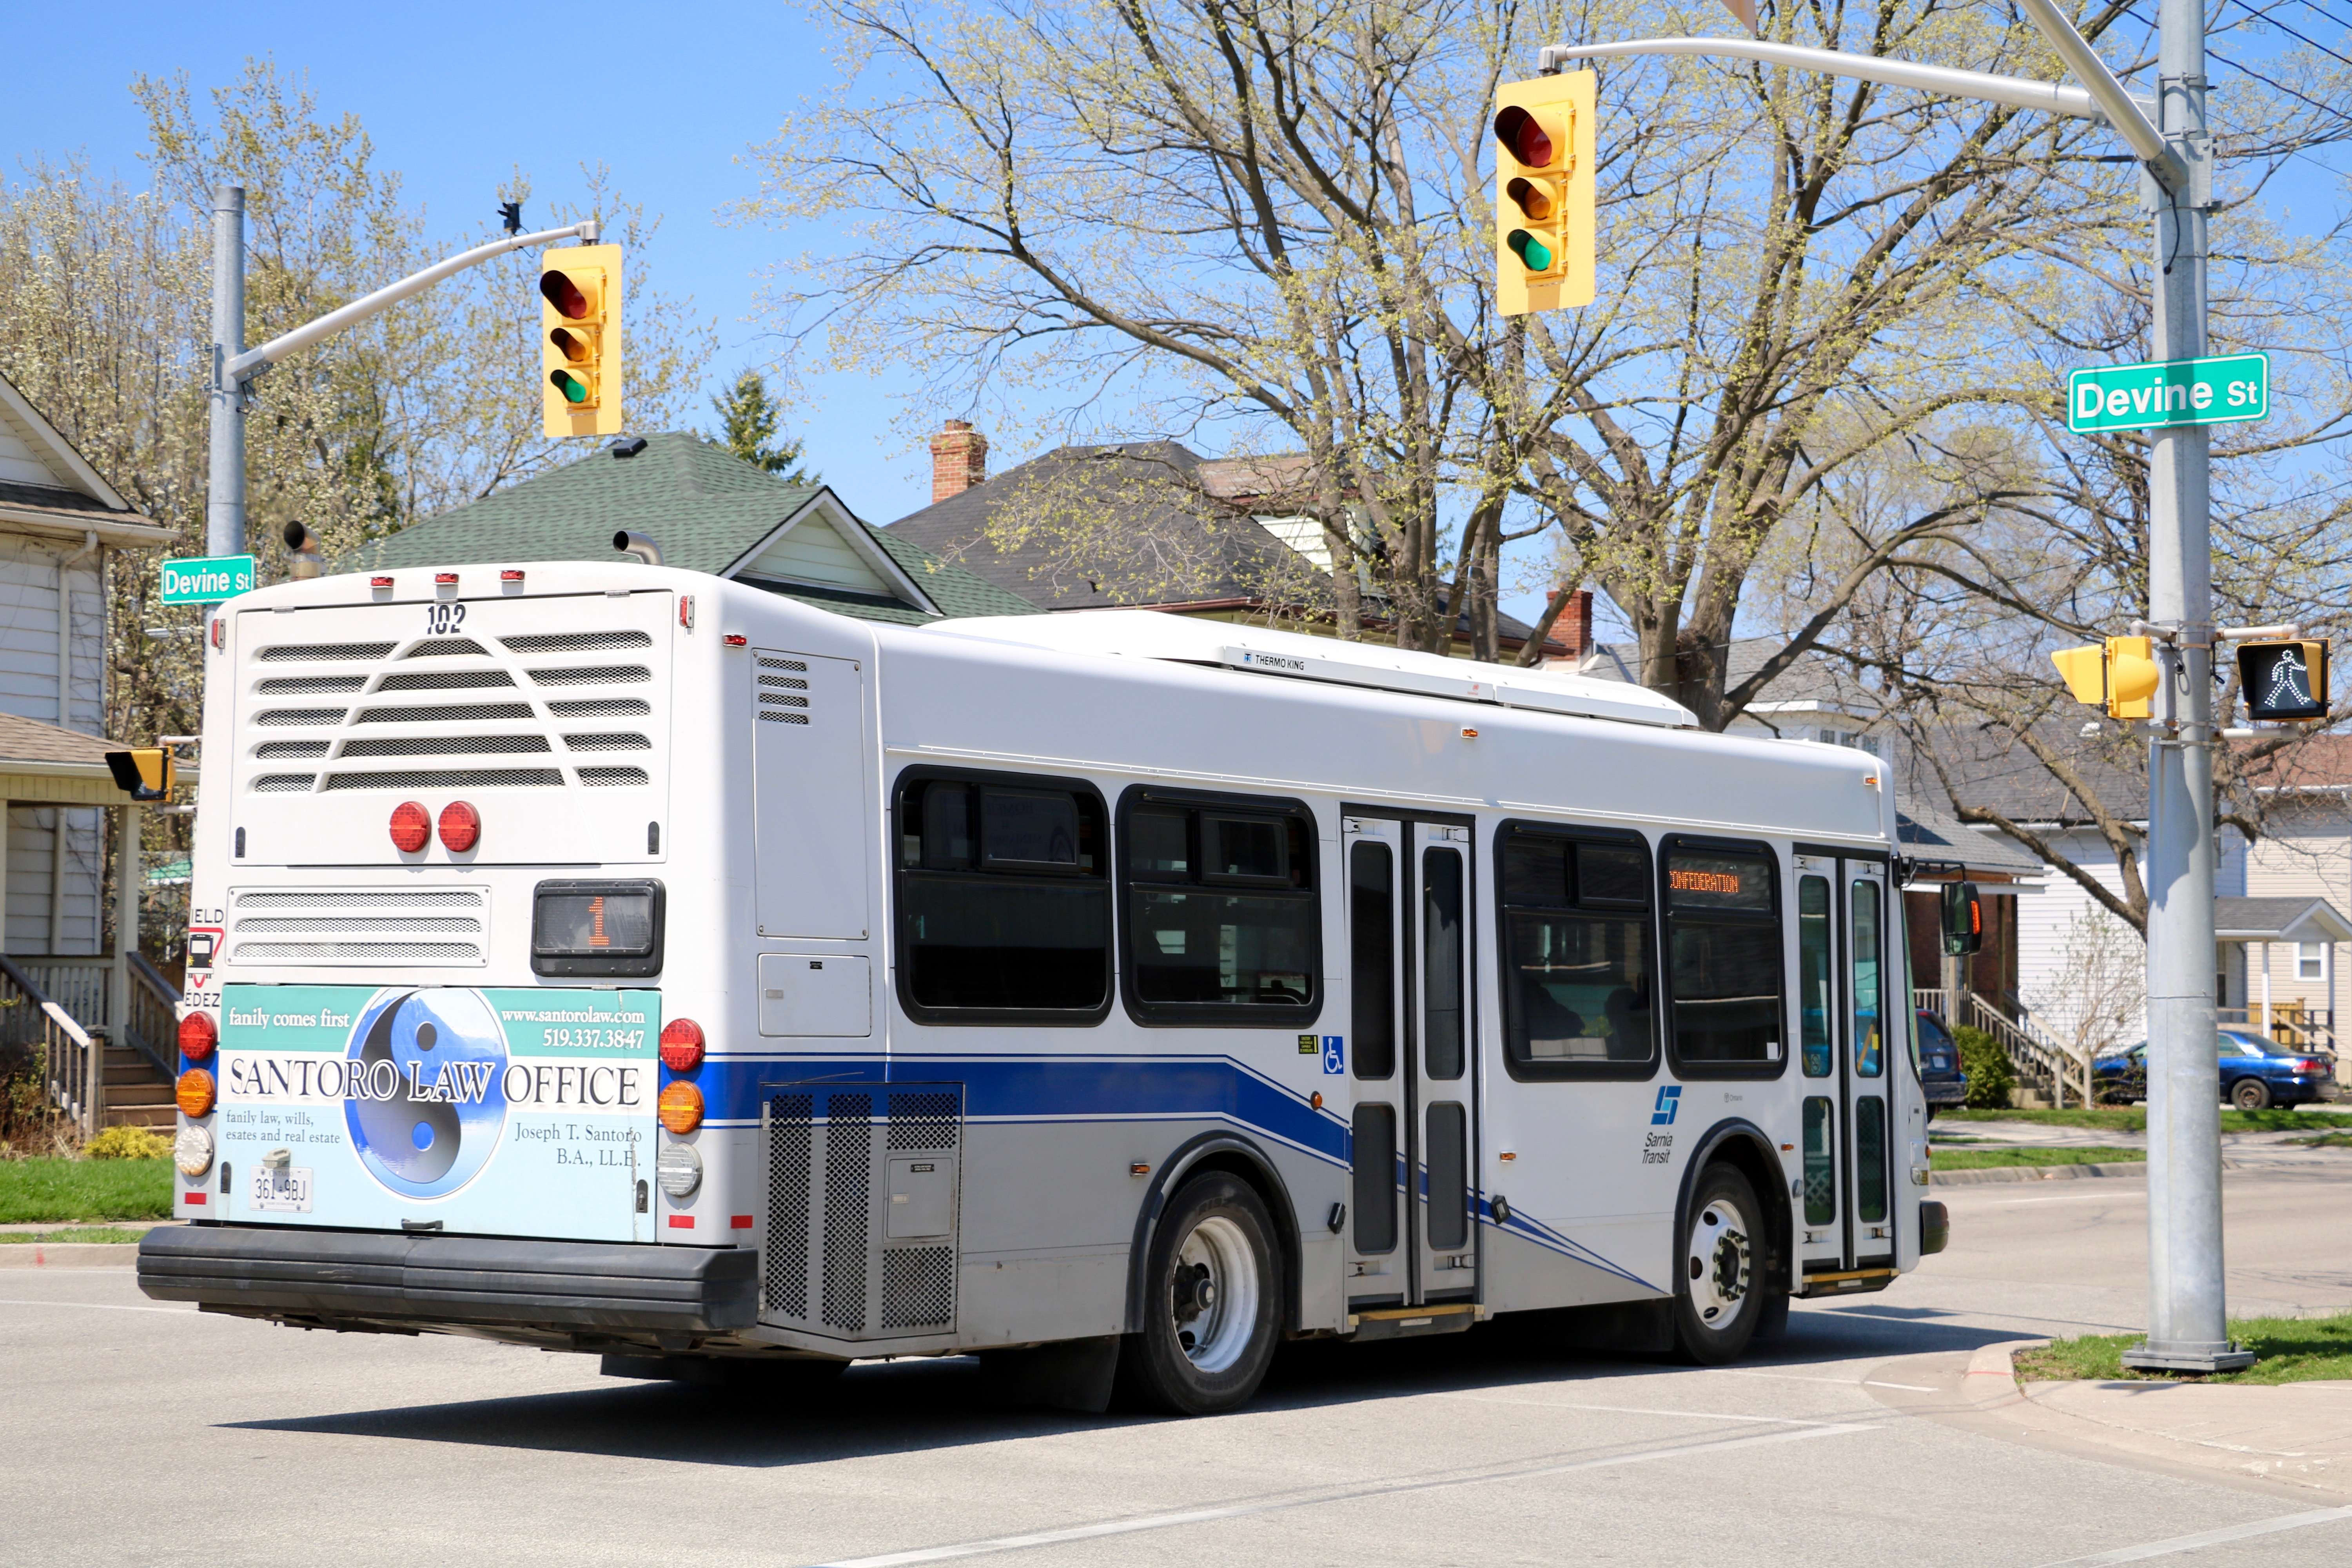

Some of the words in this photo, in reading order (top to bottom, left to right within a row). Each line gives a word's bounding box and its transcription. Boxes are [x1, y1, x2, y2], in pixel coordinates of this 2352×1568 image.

[2077, 377, 2213, 418] Devine
[2227, 381, 2258, 406] St
[165, 568, 230, 594] Devine
[235, 572, 250, 590] St
[427, 604, 466, 634] 102
[1256, 655, 1286, 668] THERMO
[1287, 659, 1304, 670] KING
[191, 909, 224, 923] IELD
[589, 897, 609, 945] 1
[185, 989, 220, 1007] ÉDEZ
[273, 1014, 316, 1027] comes
[320, 1008, 350, 1027] first
[501, 1005, 645, 1024] www.santorolaw.com
[543, 1028, 645, 1049] 519.337.3847
[230, 1058, 397, 1098] SANTORO
[409, 1062, 494, 1102] LAW
[504, 1065, 640, 1105] OFFICE
[260, 1111, 281, 1126] law,
[285, 1112, 314, 1127] wills,
[261, 1128, 280, 1141] and
[285, 1129, 305, 1142] real
[309, 1133, 340, 1143] estate
[515, 1122, 561, 1142] Joseph
[566, 1124, 579, 1140] T.
[585, 1125, 642, 1142] Santoro
[1645, 1132, 1673, 1147] Sarnia
[557, 1148, 593, 1168] B.A.,
[1642, 1149, 1670, 1164] Transit
[255, 1178, 275, 1200] 361
[284, 1180, 306, 1201] 9BJ
